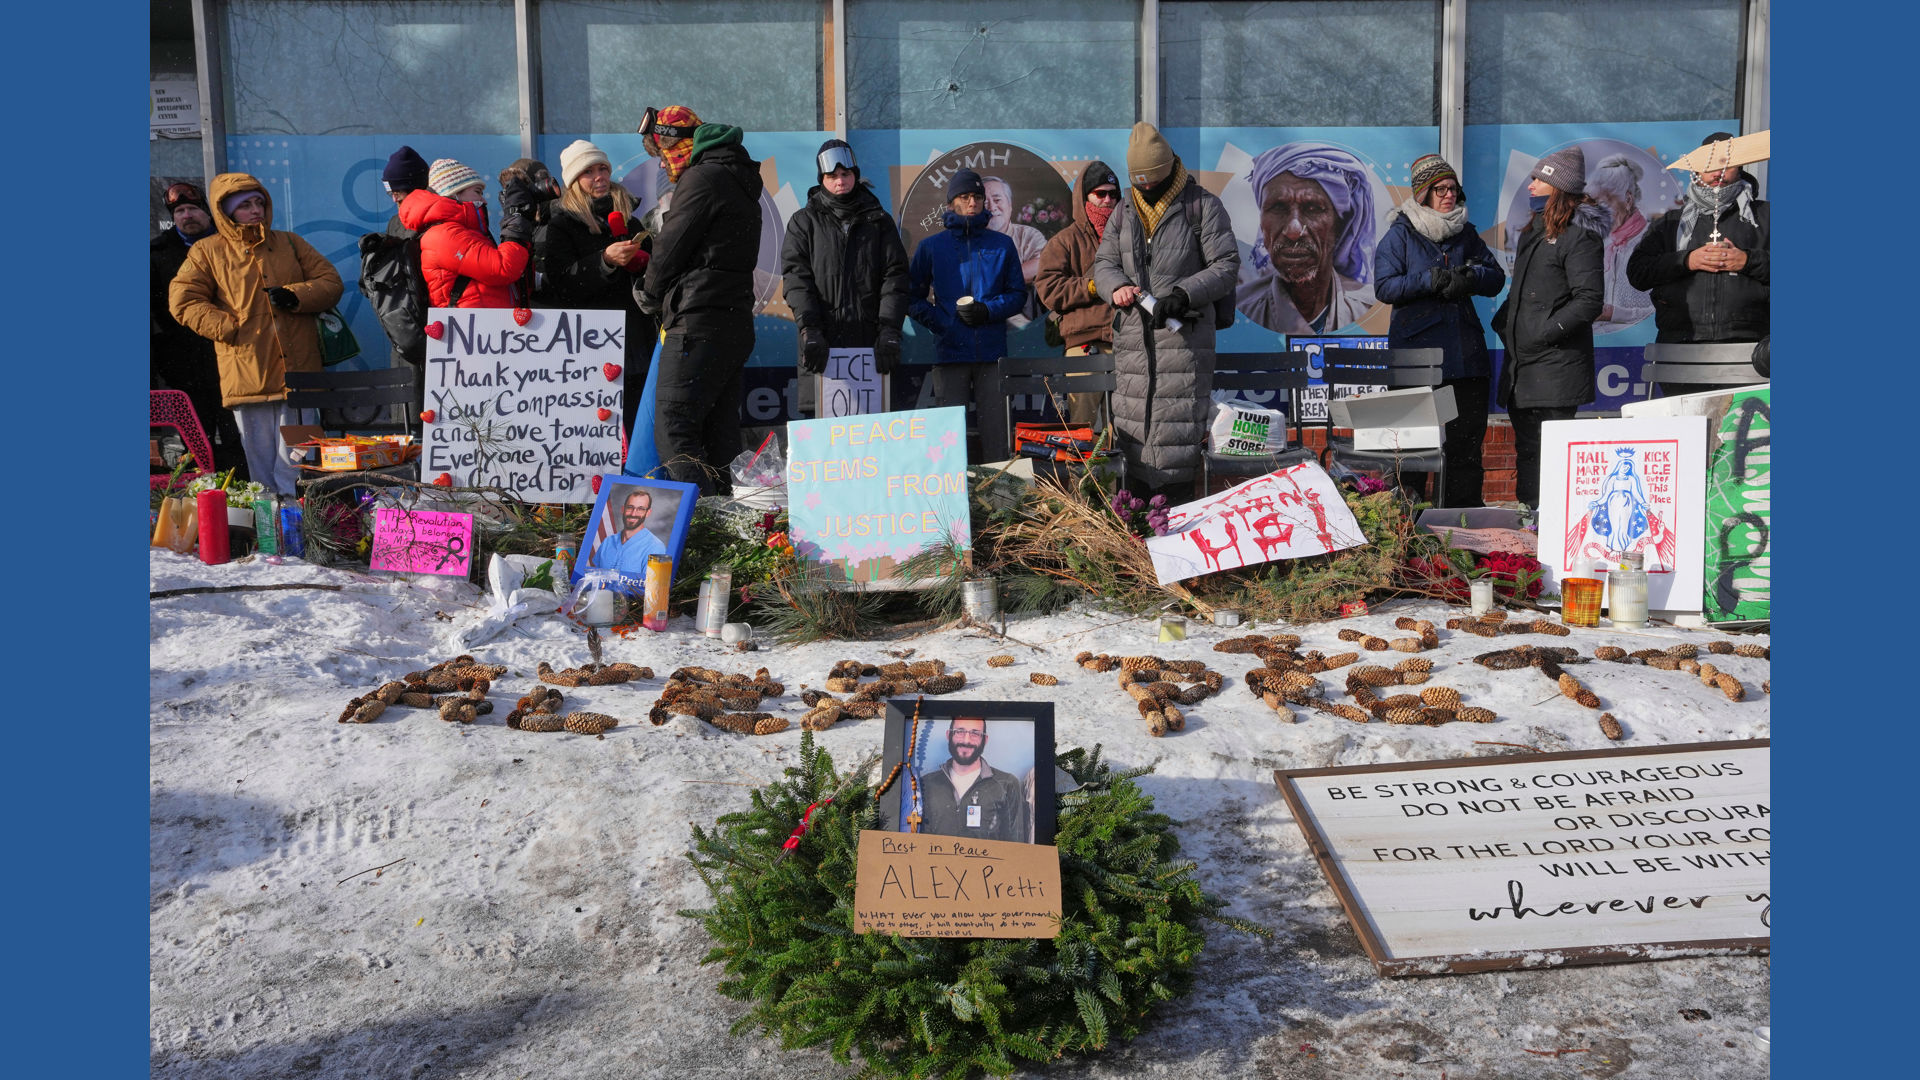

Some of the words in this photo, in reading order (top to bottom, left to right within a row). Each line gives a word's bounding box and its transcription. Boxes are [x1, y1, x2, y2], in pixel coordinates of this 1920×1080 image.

[447, 313, 541, 355] Nurse
[429, 358, 510, 387] Thank
[514, 366, 554, 392] you
[555, 359, 598, 383] for
[831, 354, 873, 383] ICE
[832, 388, 876, 417] OUT
[1301, 387, 1328, 400] THEY
[431, 389, 490, 423] Your
[495, 389, 624, 416] Compassion
[432, 424, 478, 443] and
[487, 419, 546, 444] Love
[550, 415, 622, 441] toward
[830, 417, 926, 447] PEACE
[1232, 419, 1270, 438] HOME
[1228, 438, 1266, 452] STORE!
[1644, 451, 1671, 462] KICK
[430, 445, 541, 473] Everyone
[542, 442, 577, 467] You
[579, 442, 621, 467] have
[789, 456, 879, 483] STEMS
[1576, 451, 1608, 464] HAIL
[468, 462, 544, 492] Cared
[549, 466, 585, 491] For
[1576, 465, 1608, 476] MARY
[886, 471, 966, 498] FROM
[1575, 487, 1600, 496] Grace
[1648, 483, 1668, 493] This
[1649, 493, 1672, 504] Place
[380, 509, 406, 523] The
[817, 511, 939, 538] JUSTICE
[378, 535, 389, 545] to
[379, 524, 415, 535] always
[421, 526, 465, 539] belonged
[1327, 786, 1367, 800] BE
[1375, 778, 1503, 798] STRONG
[1510, 778, 1528, 789] &
[1532, 762, 1743, 789] COURAGEOUS
[1401, 803, 1449, 817] DO
[1457, 798, 1521, 814] NOT
[1533, 795, 1576, 810] BE
[1585, 787, 1694, 807] AFRAID
[1553, 815, 1602, 831] OR
[882, 838, 917, 853] Rest
[930, 843, 943, 852] in
[953, 842, 989, 856] Peace
[1373, 847, 1441, 862] FOR
[1447, 843, 1518, 859] THE
[1523, 838, 1614, 856] LORD
[1620, 831, 1720, 849] YOUR
[1539, 860, 1628, 878] WILL
[1633, 857, 1681, 873] BE
[880, 864, 970, 901] ALEX
[983, 865, 1044, 899] Pretti
[1469, 880, 1711, 921] wherever
[858, 911, 895, 919] WHAT
[930, 912, 946, 920] you
[979, 912, 997, 921] your
[1002, 911, 1051, 920] government
[954, 921, 994, 931] eventually
